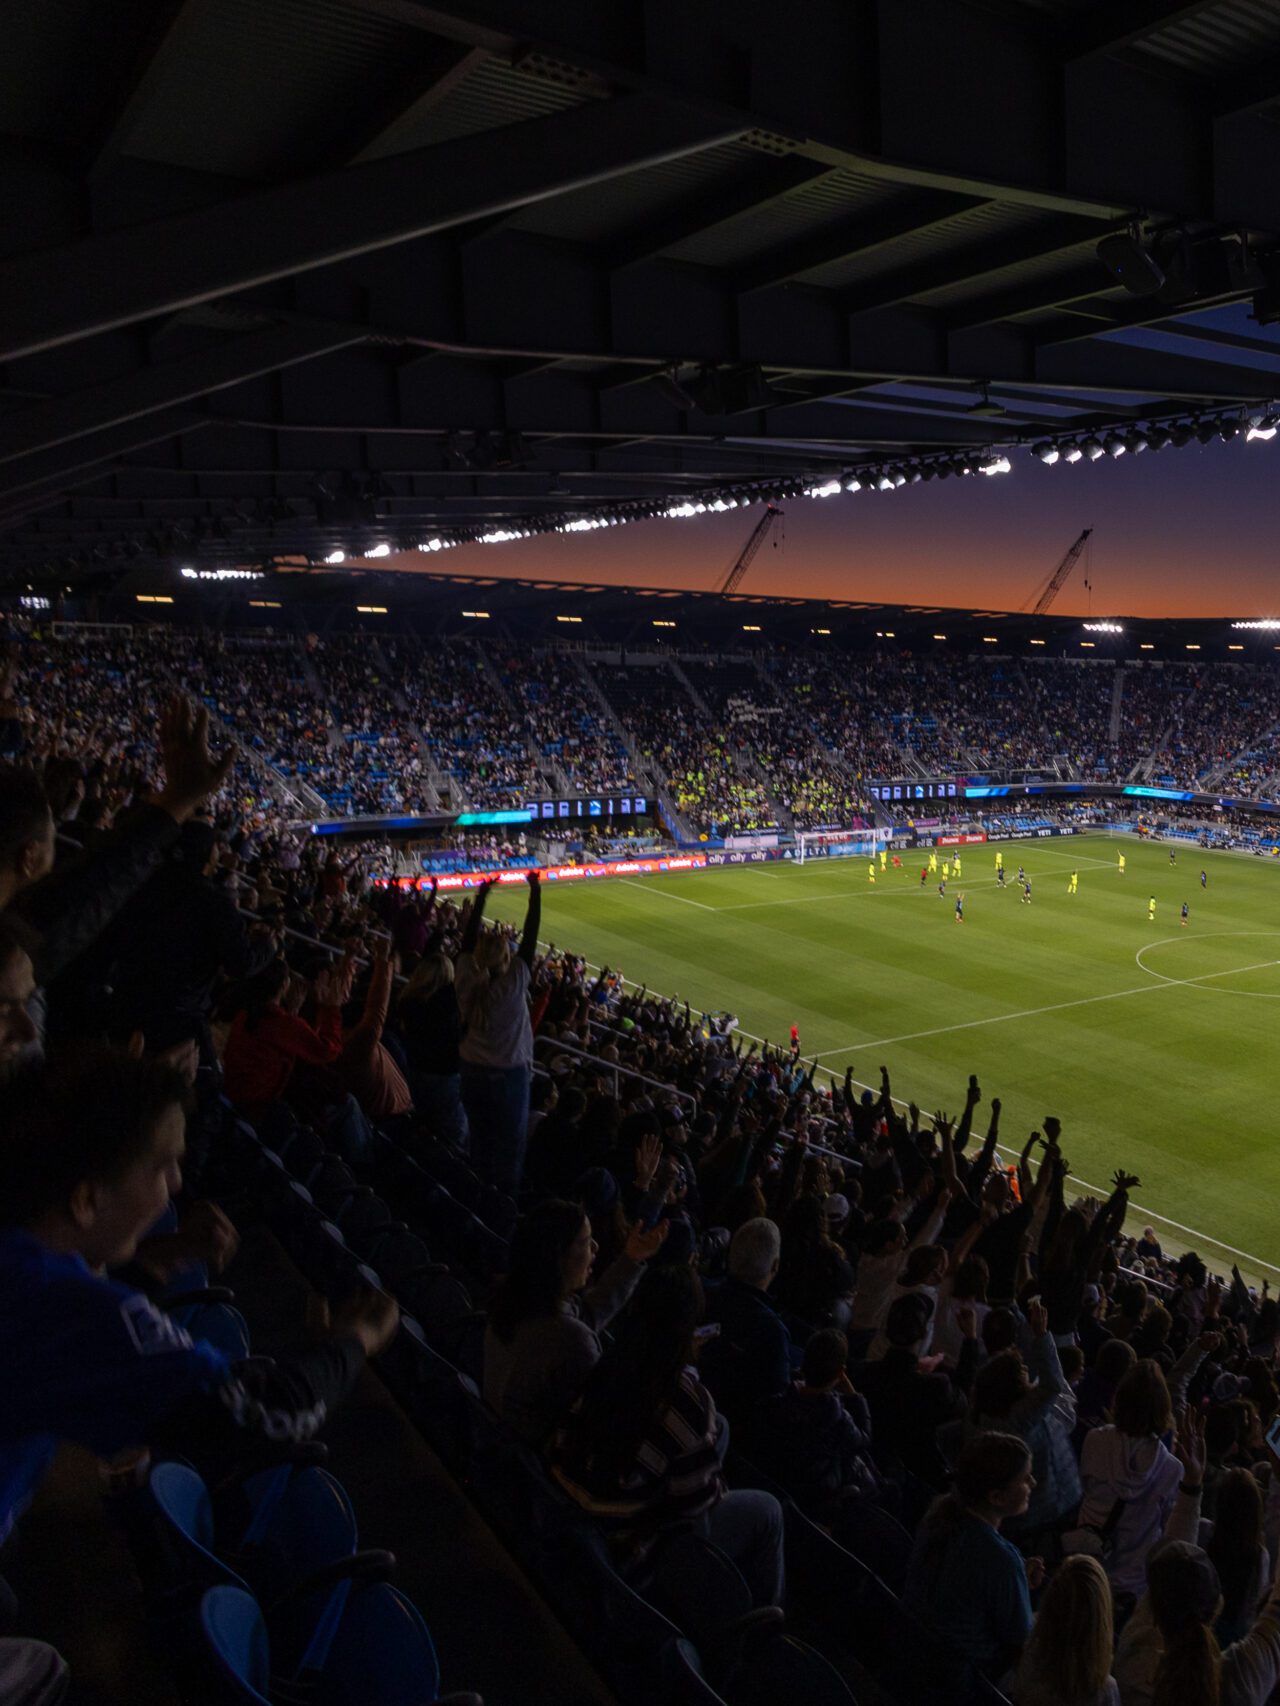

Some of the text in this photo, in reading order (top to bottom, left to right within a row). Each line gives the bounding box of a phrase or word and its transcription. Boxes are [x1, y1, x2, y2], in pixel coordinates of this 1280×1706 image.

[751, 850, 767, 861] ally
[794, 846, 827, 857] DELTA
[709, 854, 725, 864] ally
[730, 852, 746, 863] ally
[615, 863, 640, 872] Adobe
[669, 859, 692, 868] Adobe
[559, 867, 584, 877] Adobe
